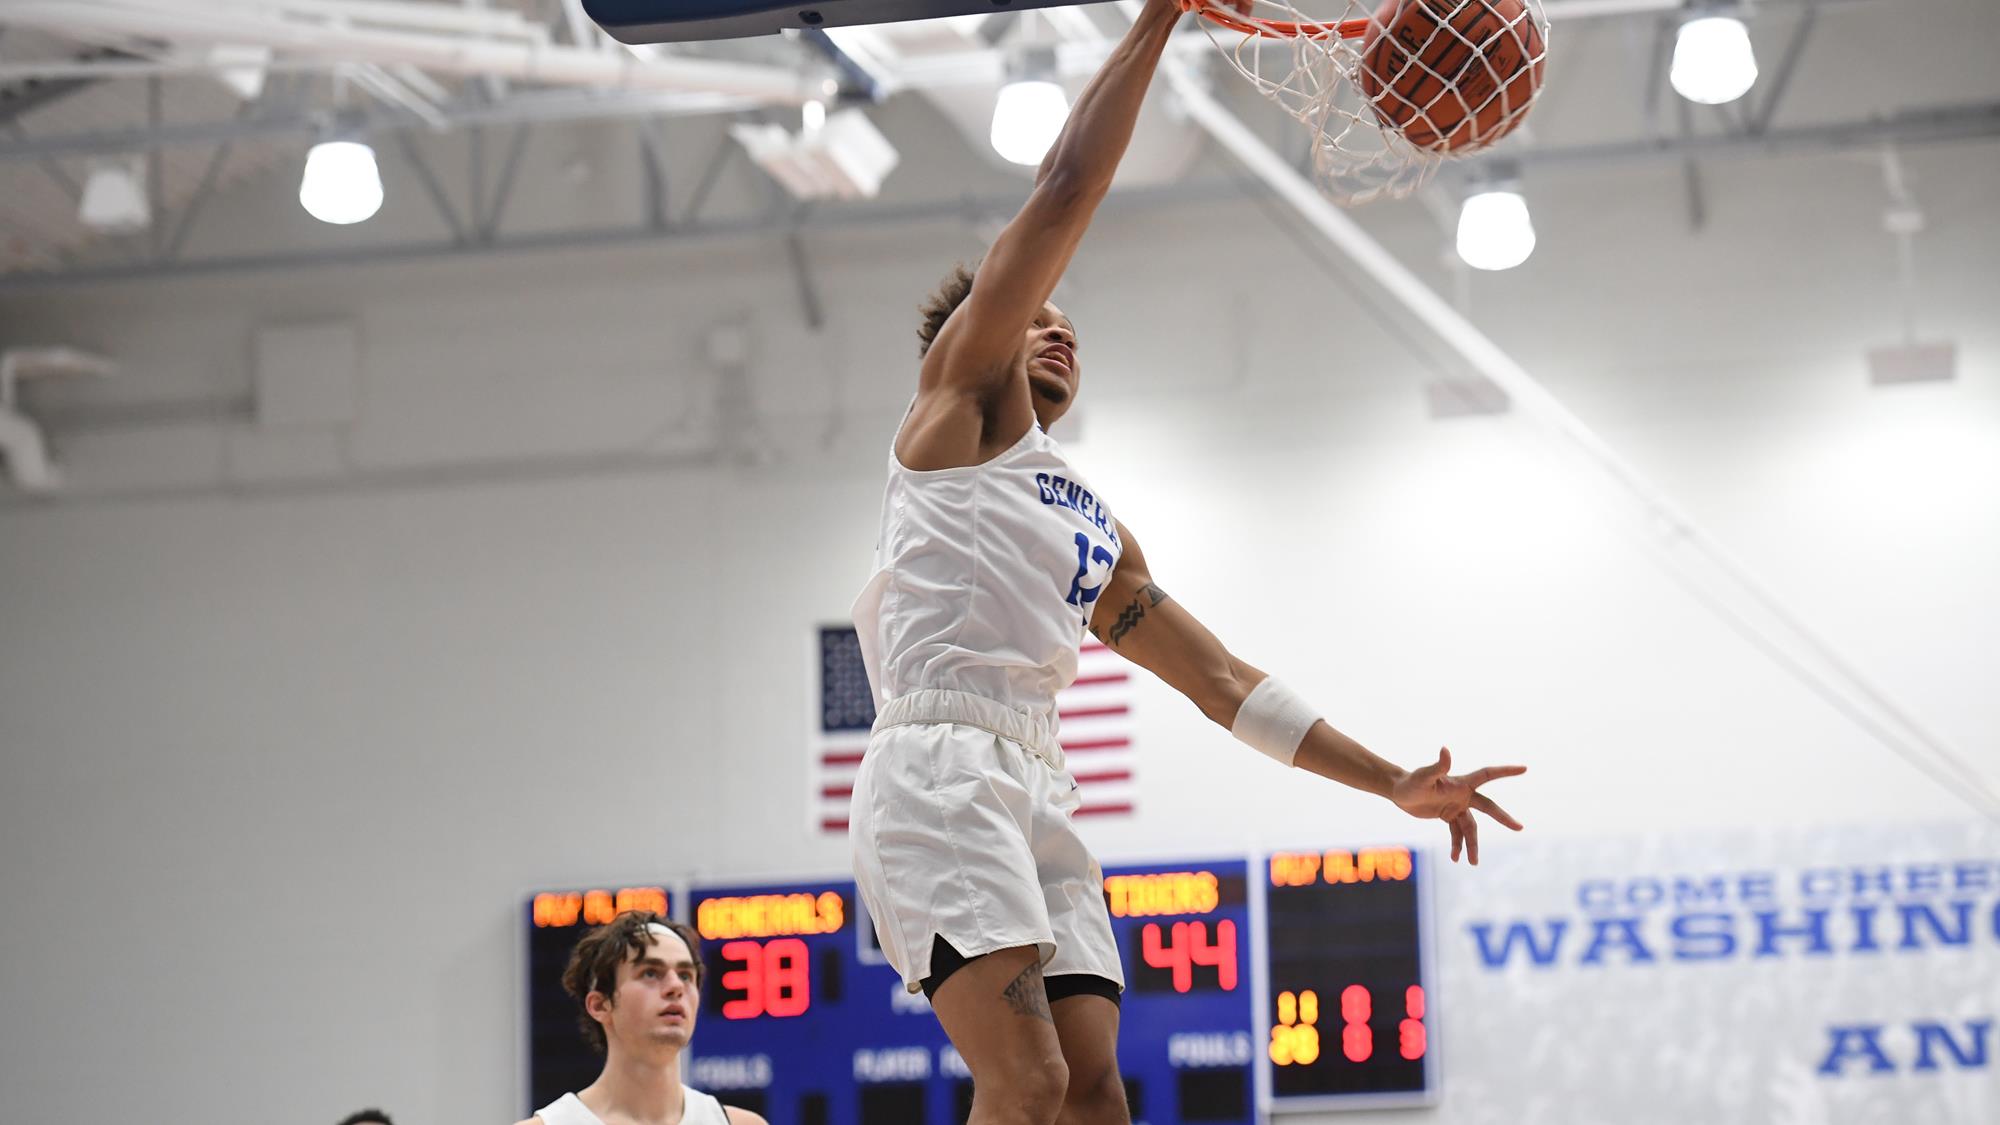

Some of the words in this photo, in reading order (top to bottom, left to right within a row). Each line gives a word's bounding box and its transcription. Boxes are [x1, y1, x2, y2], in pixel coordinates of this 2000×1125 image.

[698, 891, 843, 940] GENERALS
[1576, 871, 1777, 911] COME
[1801, 860, 2000, 899] CHEE
[722, 939, 810, 1019] 38
[1142, 919, 1237, 993] 44
